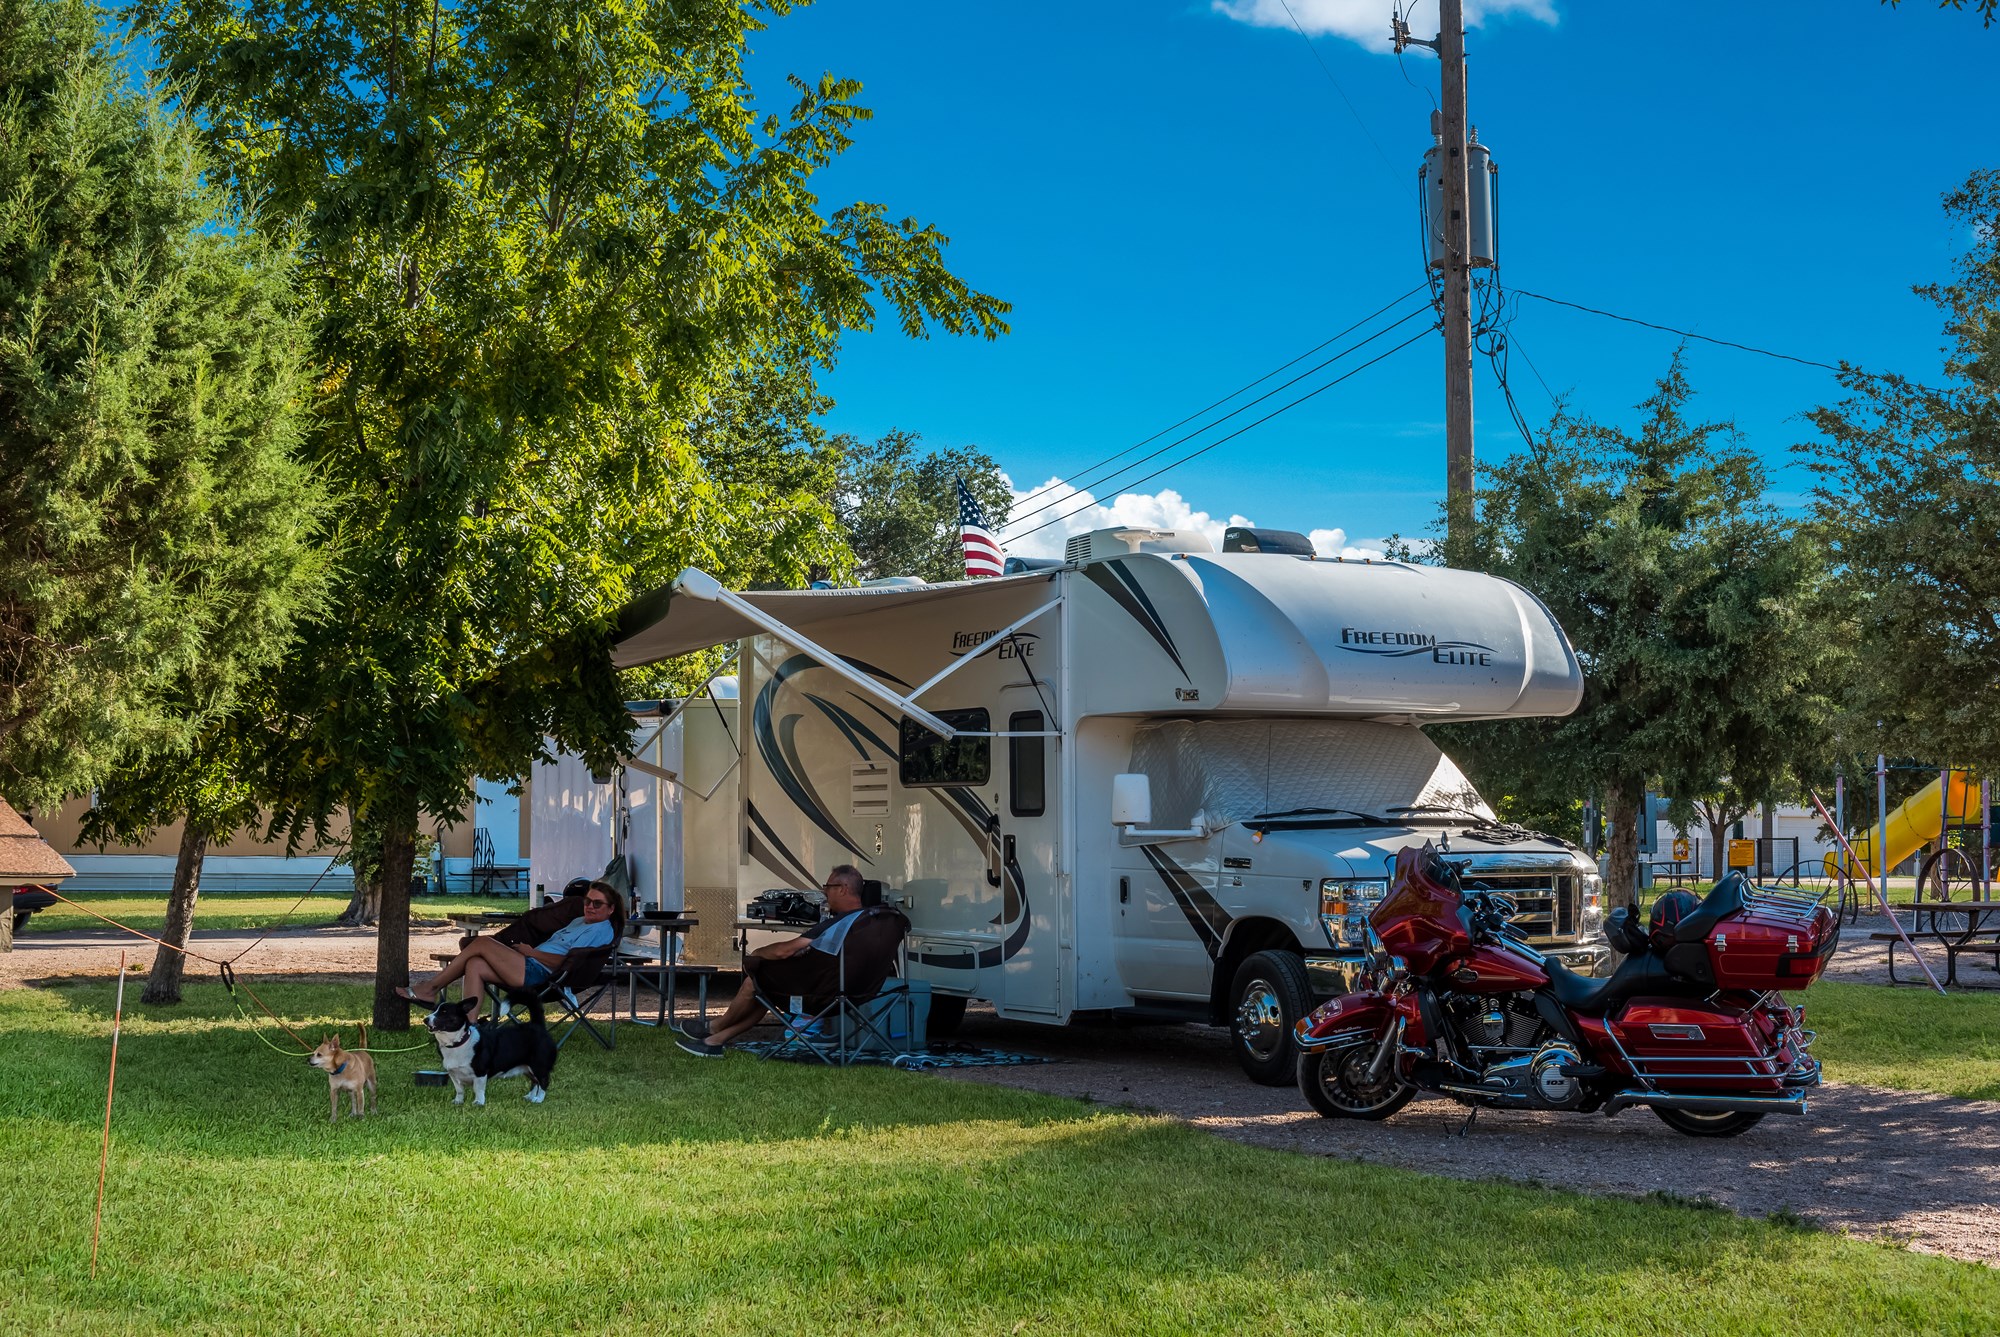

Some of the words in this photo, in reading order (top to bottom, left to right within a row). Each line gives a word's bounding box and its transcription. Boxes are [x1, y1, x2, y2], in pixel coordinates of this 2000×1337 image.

[1342, 628, 1436, 646] FREEDOM
[998, 641, 1035, 660] ELITE
[1433, 647, 1492, 667] ELITE
